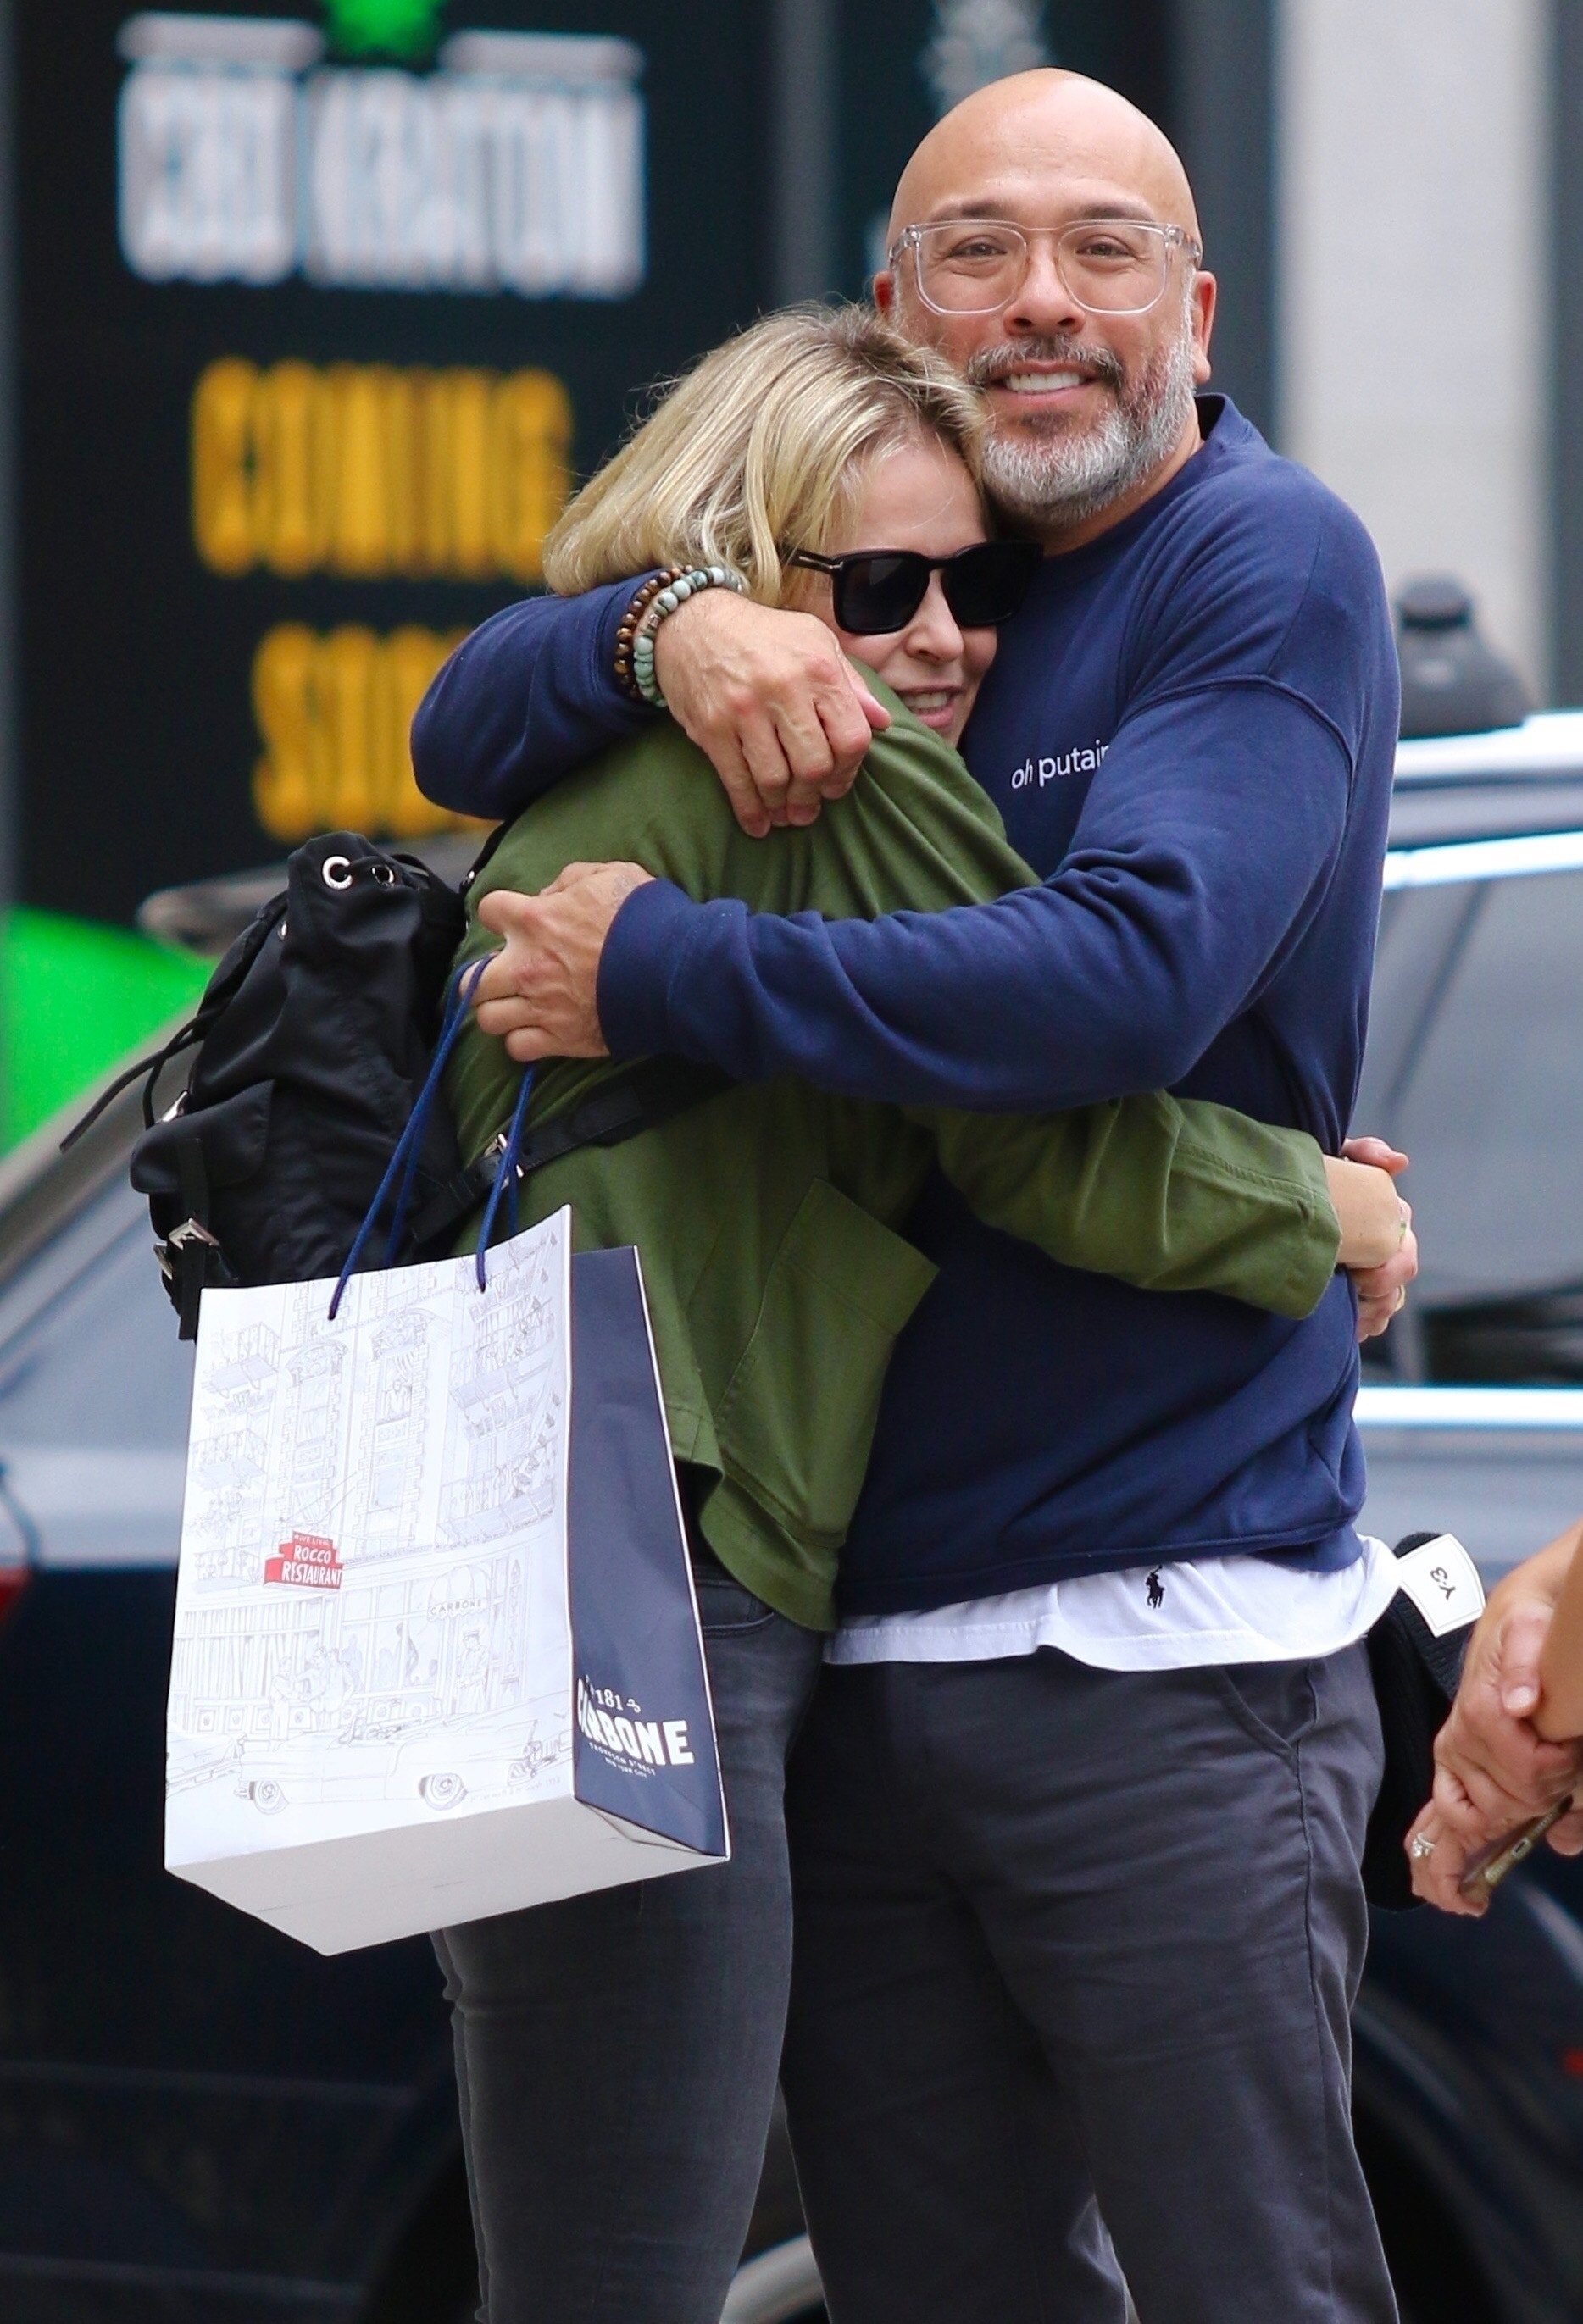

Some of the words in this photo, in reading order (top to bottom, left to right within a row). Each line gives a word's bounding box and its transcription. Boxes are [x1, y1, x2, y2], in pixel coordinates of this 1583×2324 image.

[1011, 757, 1033, 789] oh
[293, 1544, 332, 1565] ROCCO
[281, 1560, 343, 1586] RESTAURANT
[595, 1688, 624, 1711] 181
